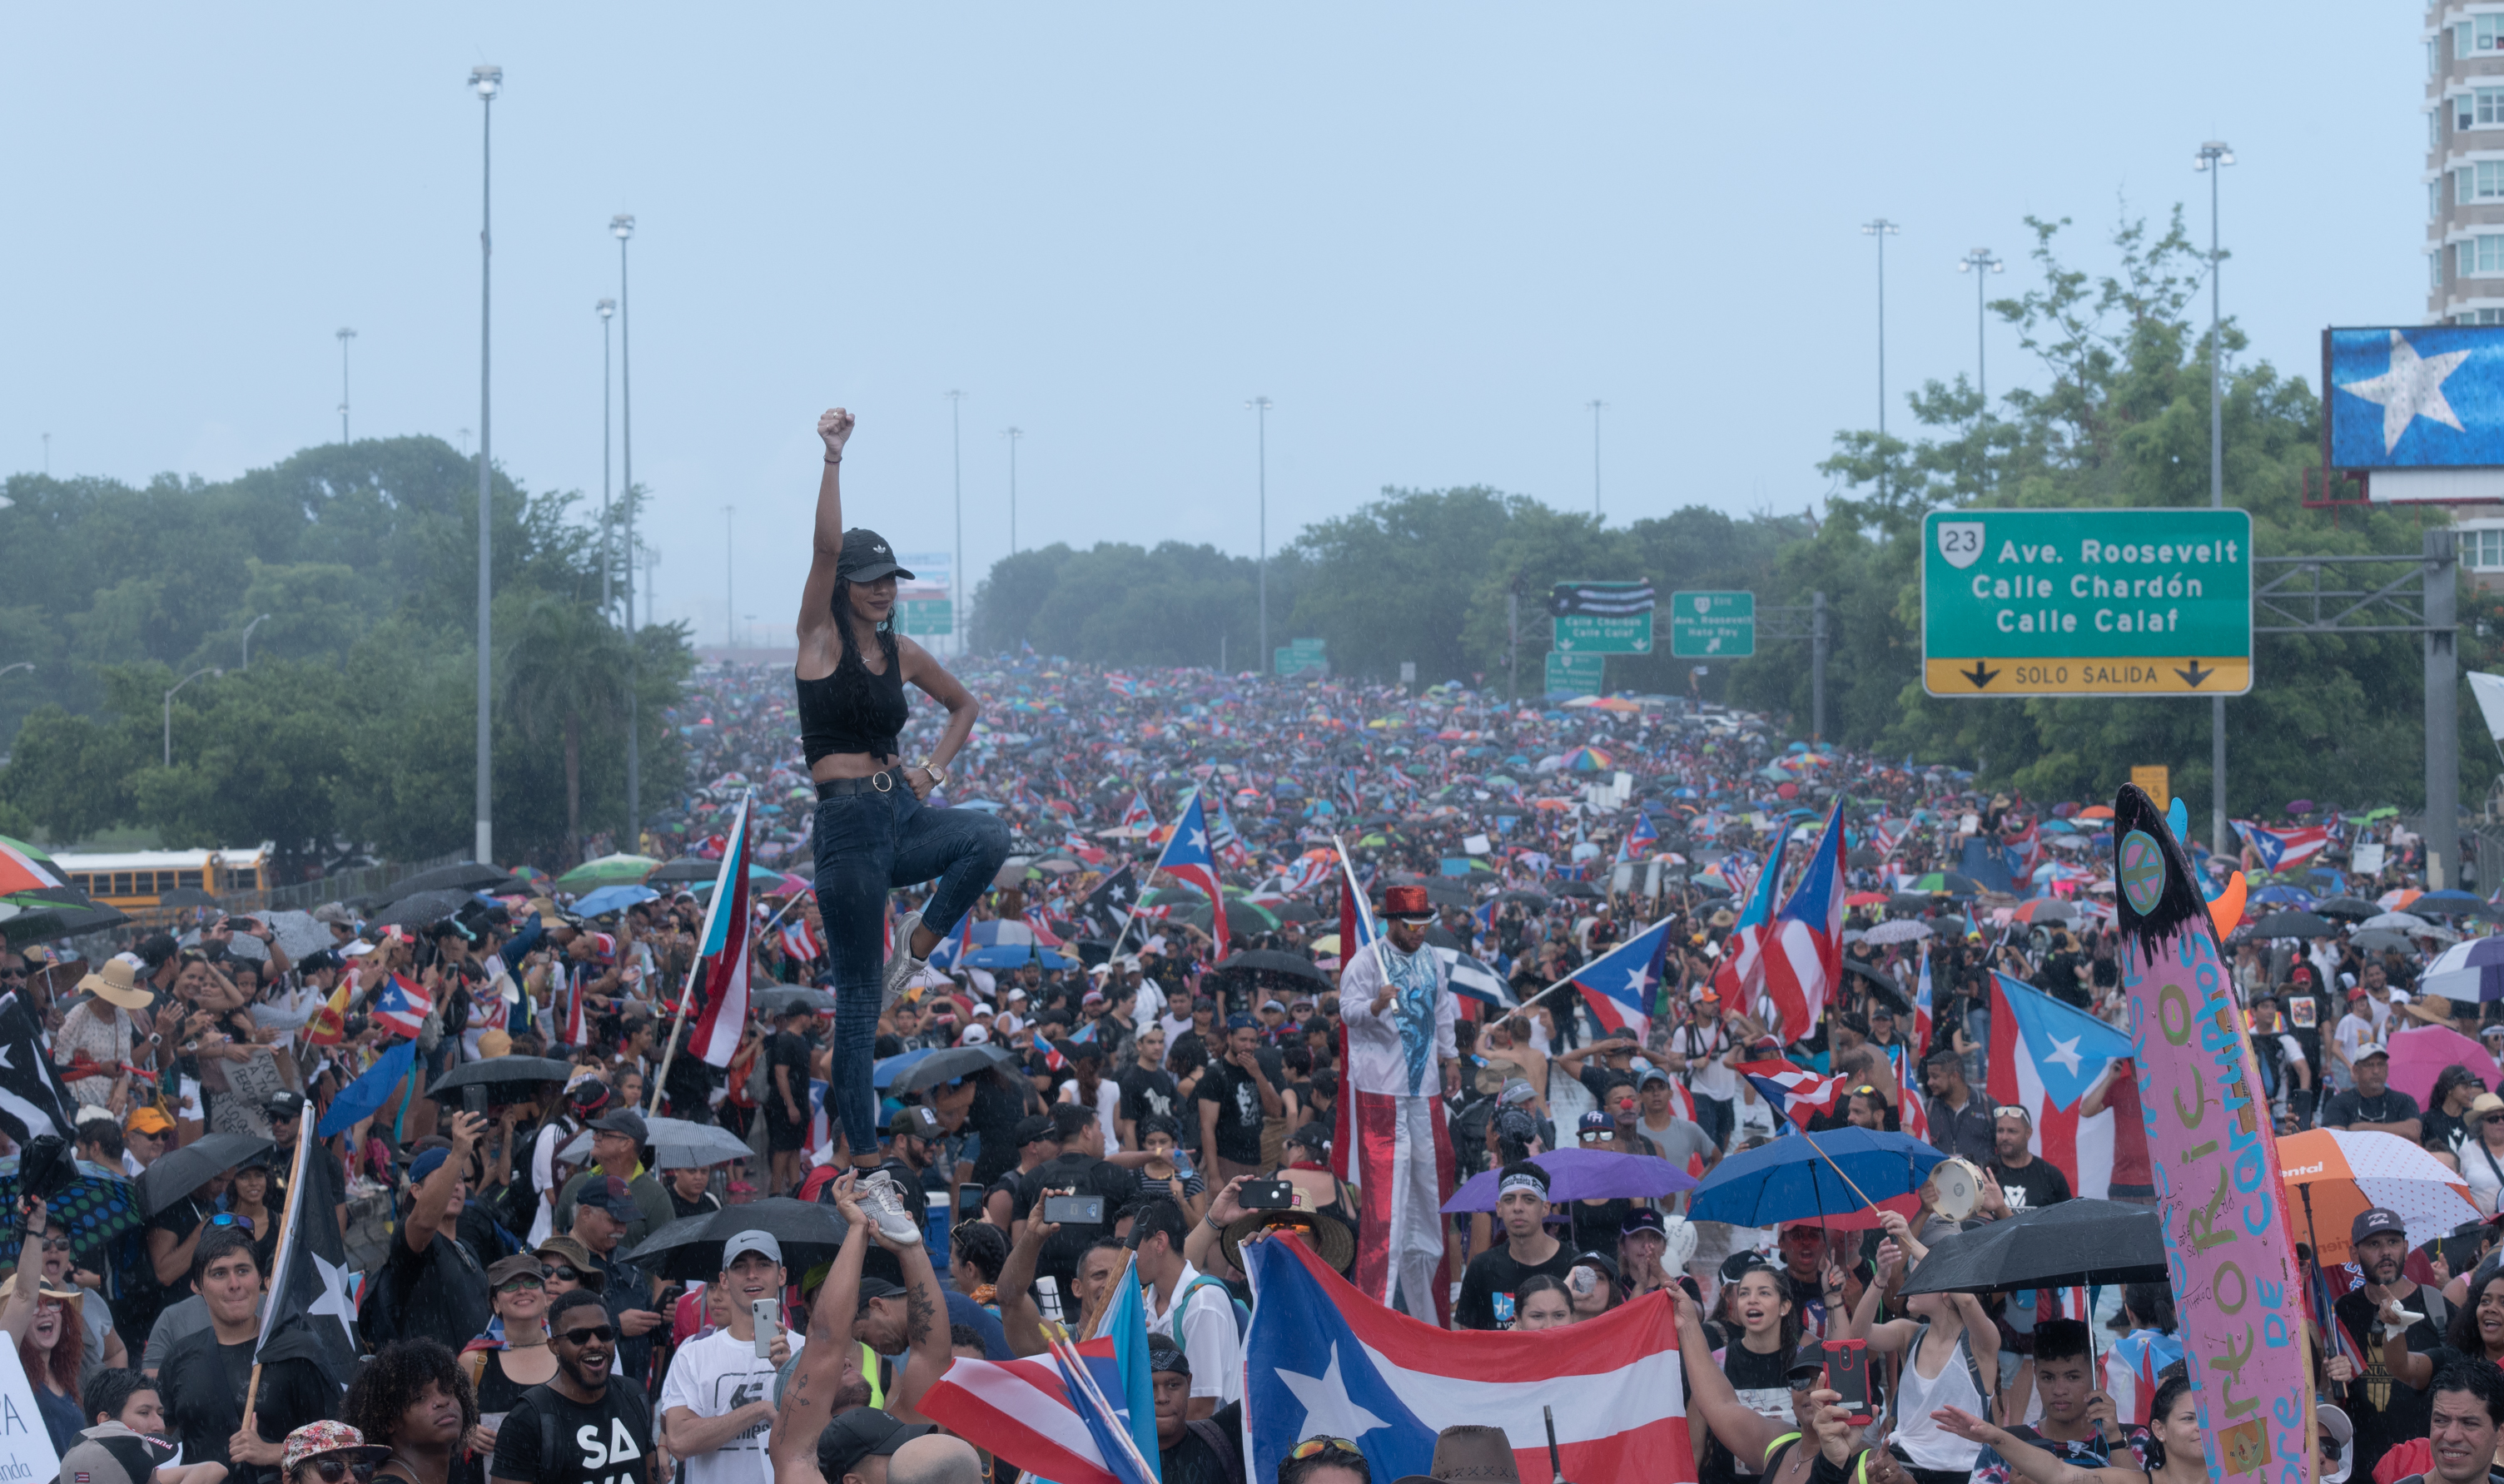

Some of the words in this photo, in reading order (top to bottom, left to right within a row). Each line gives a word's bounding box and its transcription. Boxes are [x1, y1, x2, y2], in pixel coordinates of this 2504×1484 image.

[1945, 530, 1978, 553] 23
[1998, 540, 2064, 563] Ave.
[2081, 539, 2238, 563] Roosevelt
[1971, 574, 2054, 598] Calle
[2069, 572, 2203, 598] Chardón
[1996, 609, 2078, 633] Calle
[2094, 608, 2179, 633] Calaf
[2015, 667, 2068, 684] SOLO
[2083, 666, 2158, 683] SALIDA
[256, 1053, 281, 1084] RICKY
[2278, 1161, 2323, 1177] ental
[2254, 1274, 2289, 1348] DE
